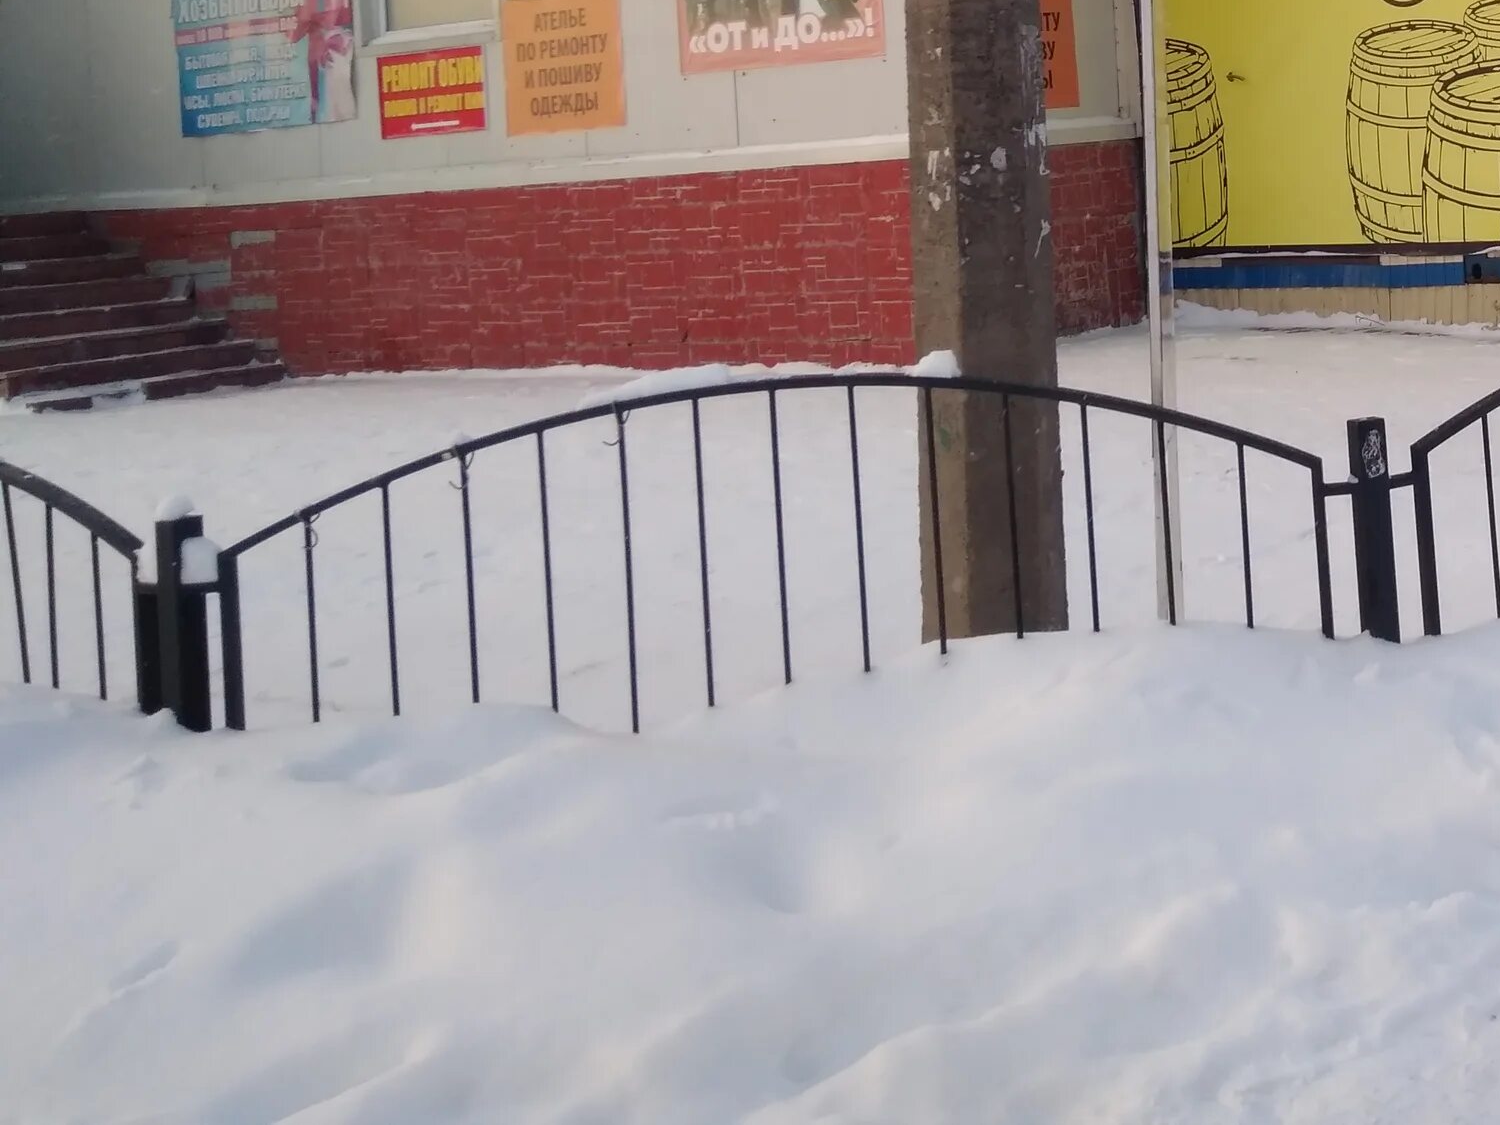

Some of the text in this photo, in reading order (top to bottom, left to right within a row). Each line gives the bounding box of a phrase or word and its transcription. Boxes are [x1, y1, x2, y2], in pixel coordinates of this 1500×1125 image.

[534, 8, 586, 32] АТЕЛЬЕ
[516, 34, 608, 62] ПО РЕМОНТУ
[525, 62, 603, 89] И ПОШИВУ
[530, 92, 599, 117] ОДЕЖДЫ
